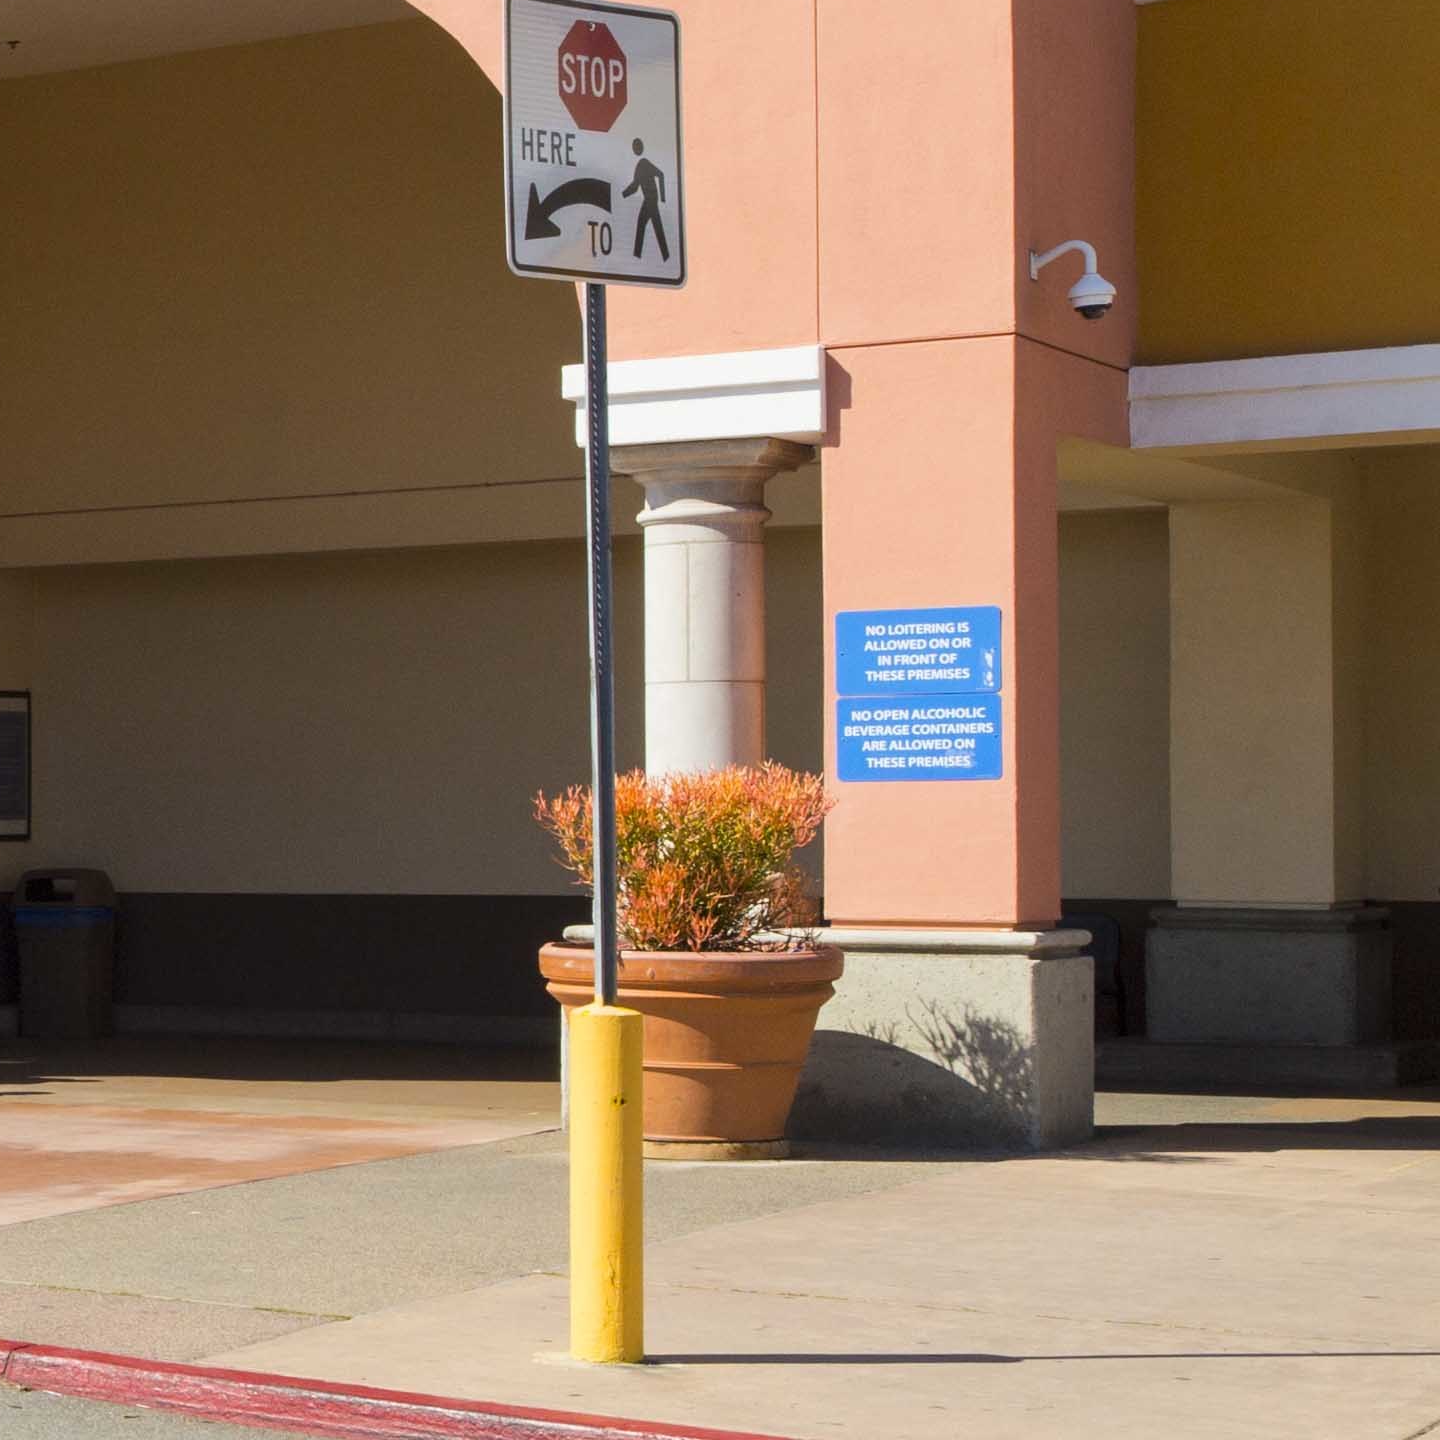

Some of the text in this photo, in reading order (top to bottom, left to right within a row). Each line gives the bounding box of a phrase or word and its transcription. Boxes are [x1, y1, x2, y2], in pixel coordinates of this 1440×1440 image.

[561, 52, 624, 99] STOP
[521, 127, 577, 167] HERE
[587, 220, 612, 258] TO
[865, 621, 970, 637] NO LOITERING IS
[864, 637, 972, 652] ALLOWED ON OR
[877, 652, 958, 666] IN FRONT OF
[865, 667, 971, 682] THESE PREMISES
[851, 707, 986, 722] NO OPEN ALCOHOLIC
[844, 722, 994, 737] BEVERAGE CONTAINERS
[862, 738, 976, 752] ARE ALLOWED ON
[866, 755, 972, 769] THESE PREMISES
